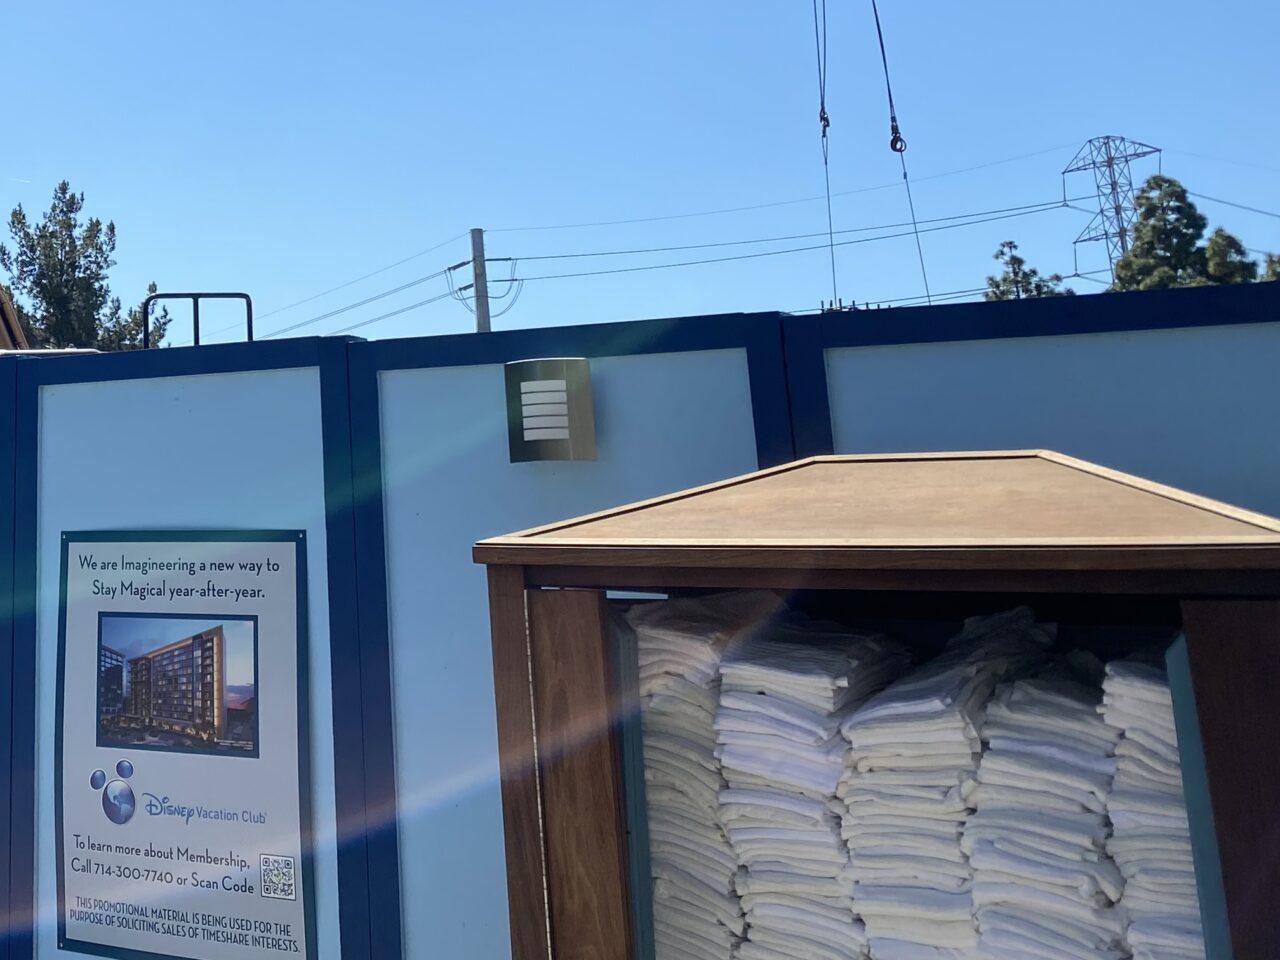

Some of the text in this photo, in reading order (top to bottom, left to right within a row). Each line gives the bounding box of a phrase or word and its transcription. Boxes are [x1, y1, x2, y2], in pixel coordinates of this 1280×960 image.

[79, 555, 279, 575] We are Imagineering a new way to
[92, 579, 265, 601] Stay Magical year-after-year.
[142, 793, 266, 825] Disney Vacation Club
[73, 834, 250, 870] To learn more about Membership,
[71, 858, 255, 894] Call 714-300-7740 or Scan Code
[70, 910, 300, 952] PURPOSE OF SOLICITING SALES OF TIMESHARE INTERESTS.
[76, 896, 291, 936] THIS PROMOTIONAL MATERIAL IS BEING USED FOR THE
